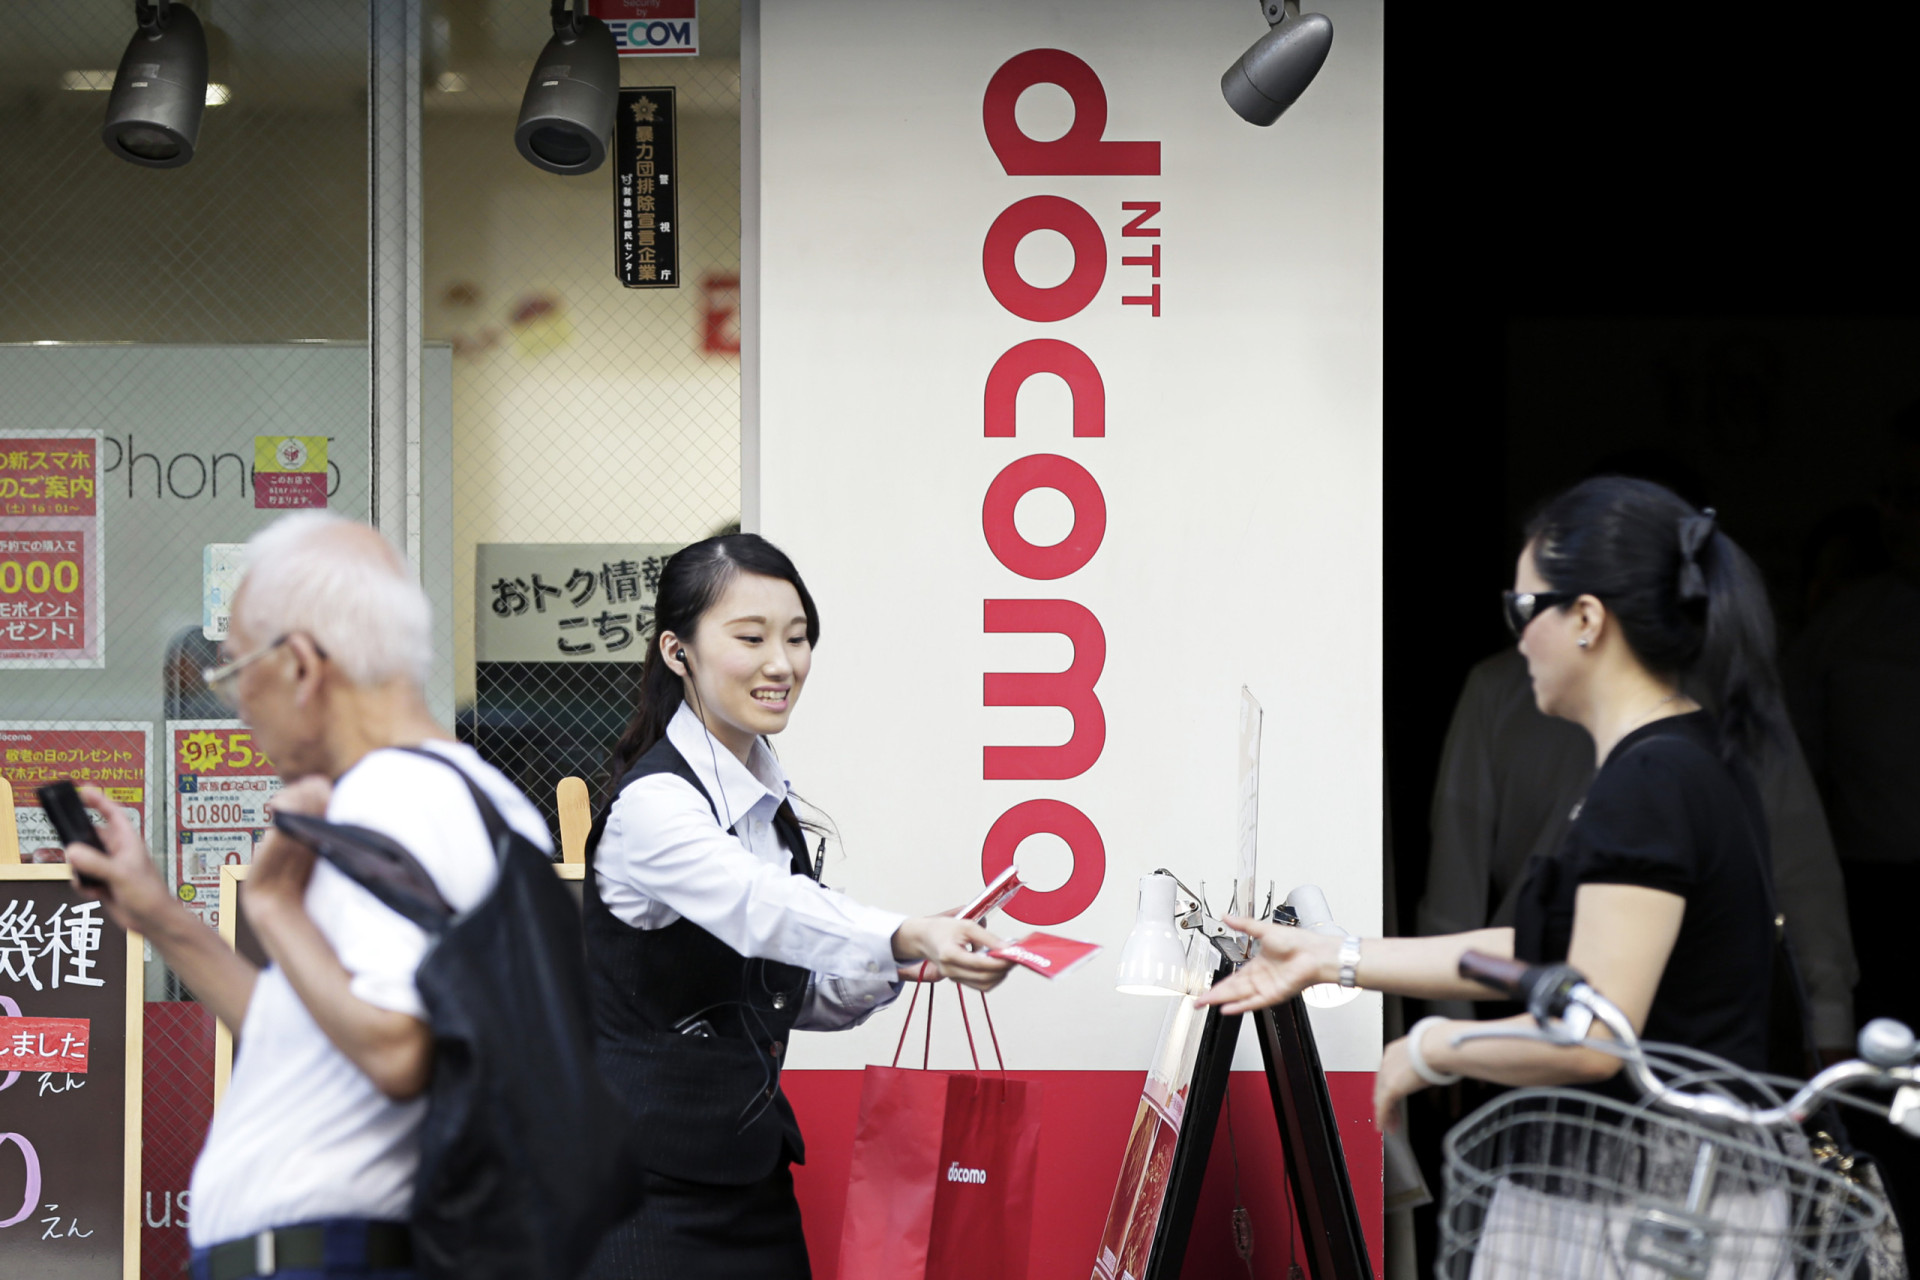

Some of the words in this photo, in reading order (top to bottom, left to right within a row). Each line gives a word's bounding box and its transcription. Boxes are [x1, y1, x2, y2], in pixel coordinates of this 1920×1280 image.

[636, 8, 648, 18] by
[608, 21, 691, 46] ECOM
[636, 126, 657, 280] 暴力団排除宣言企業
[1121, 201, 1161, 317] NTT
[983, 48, 1161, 925] docomo
[0, 621, 75, 641] ゼント!
[0, 766, 144, 781] マホデビューのきっかけに!!
[187, 804, 242, 824] 10,800
[947, 1161, 987, 1185] docomo
